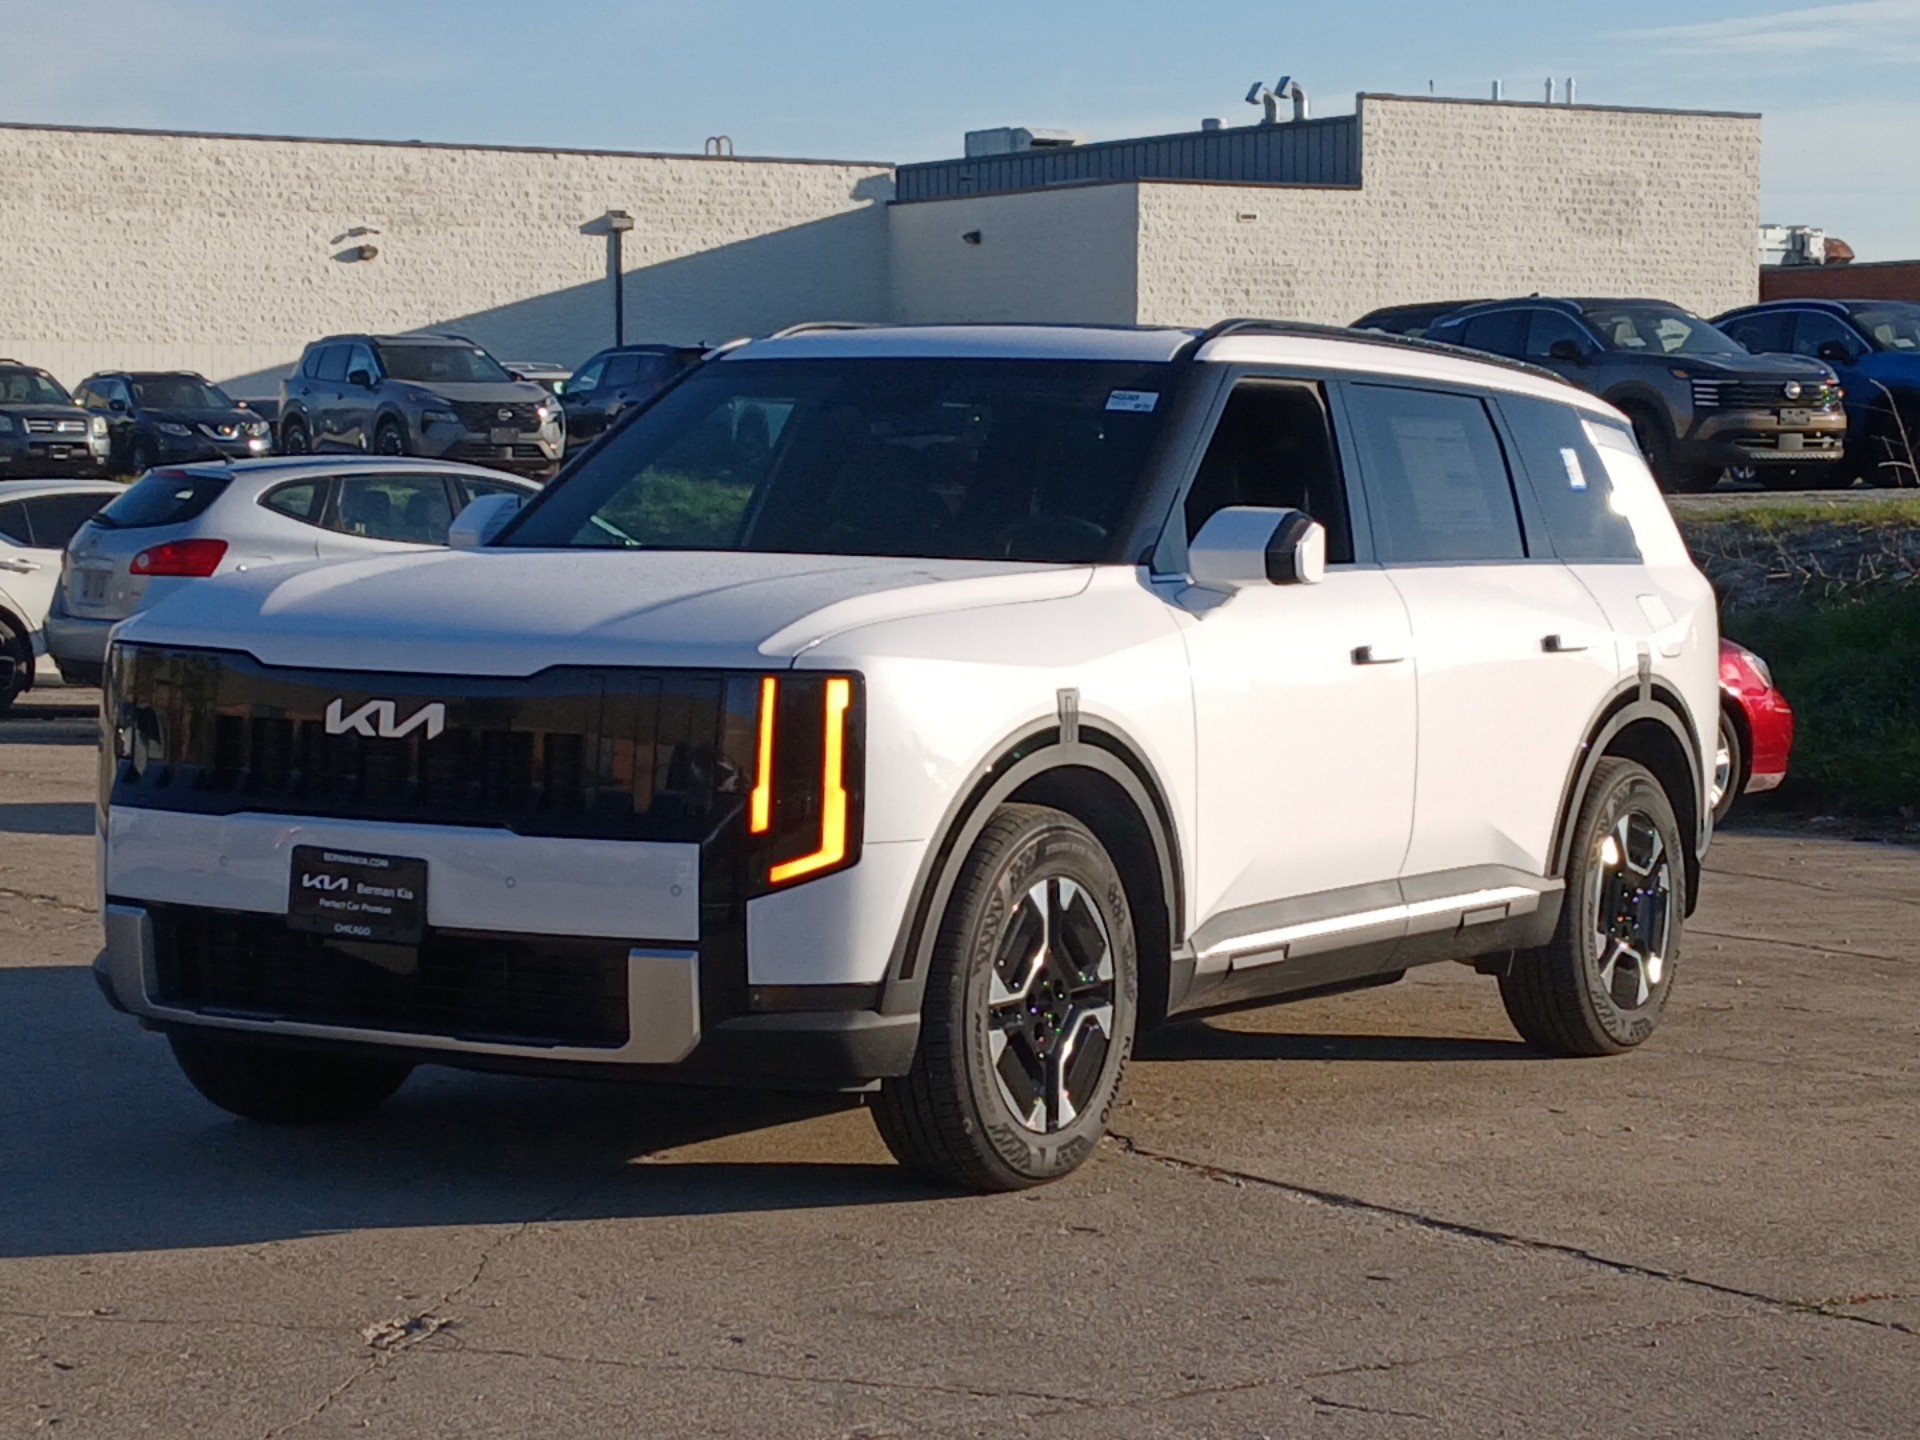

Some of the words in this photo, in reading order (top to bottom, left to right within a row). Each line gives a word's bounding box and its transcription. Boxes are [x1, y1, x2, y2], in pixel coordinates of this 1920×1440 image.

[325, 698, 446, 740] KIA
[302, 873, 349, 891] KIA
[334, 923, 371, 936] CHICAGO
[1100, 1036, 1132, 1124] KUMHO
